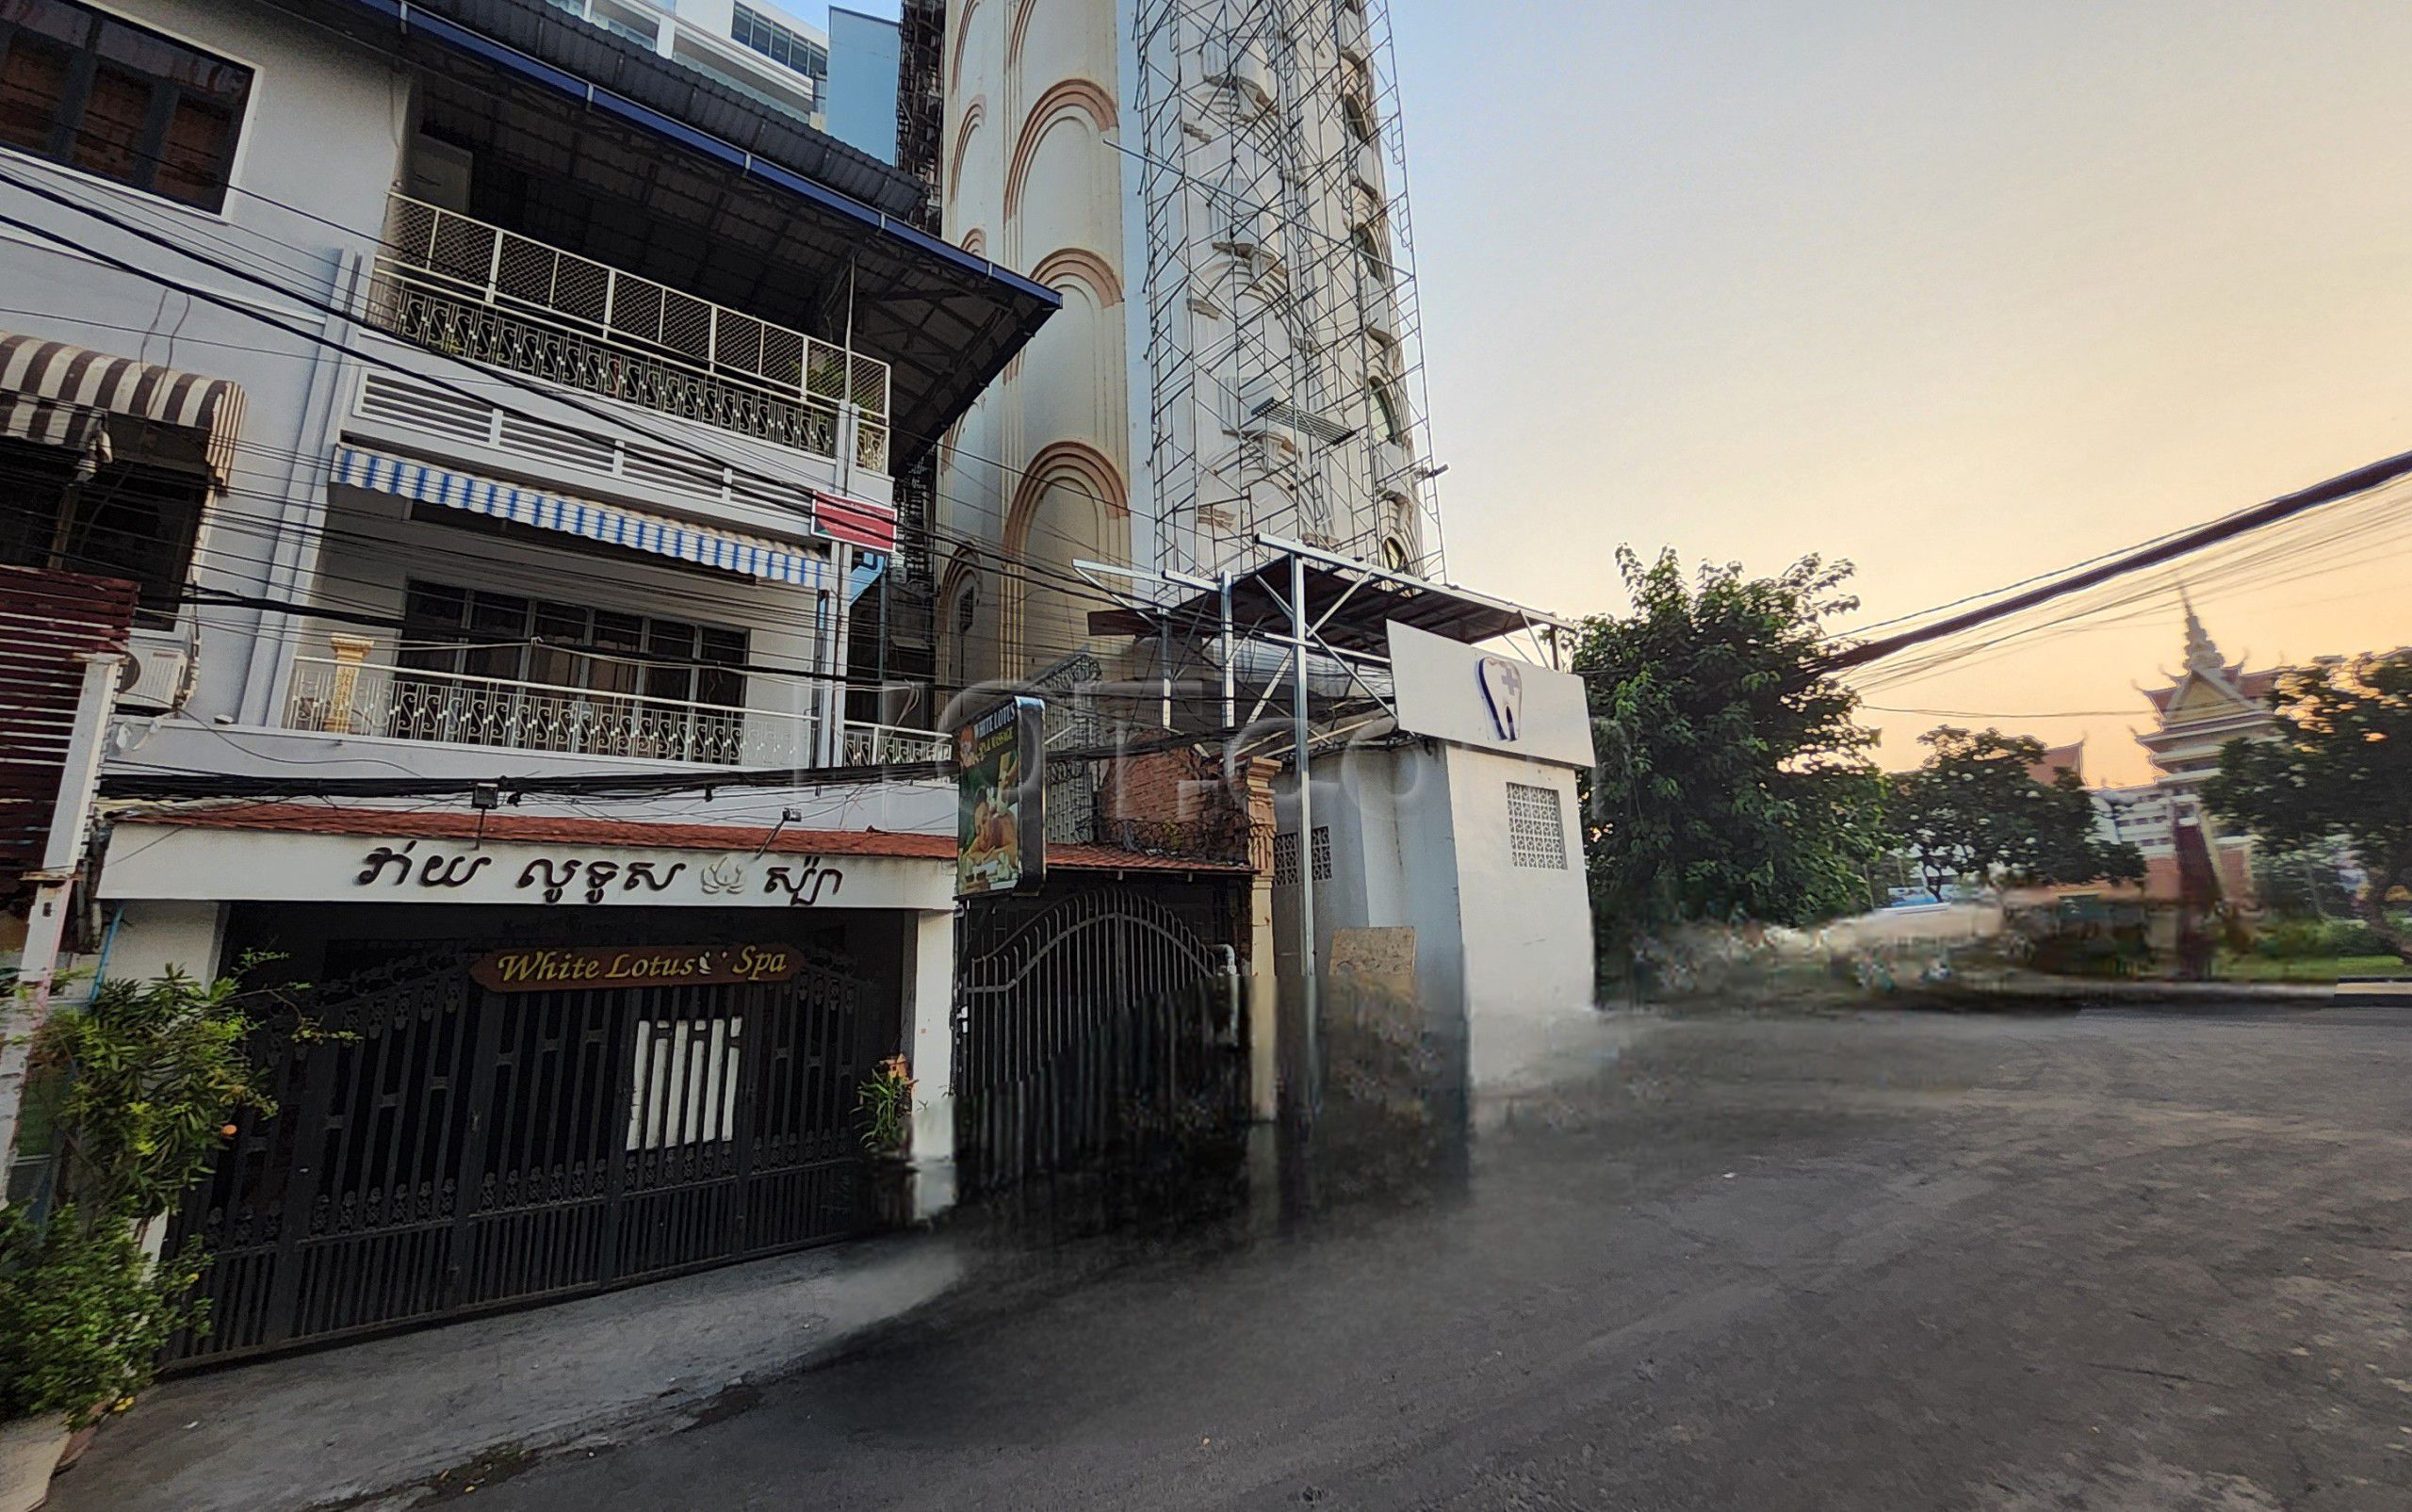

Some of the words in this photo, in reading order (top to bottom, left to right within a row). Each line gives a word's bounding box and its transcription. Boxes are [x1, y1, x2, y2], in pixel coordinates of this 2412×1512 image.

[497, 951, 600, 982] White
[605, 952, 695, 979] Lotus
[732, 945, 788, 981] Spa
